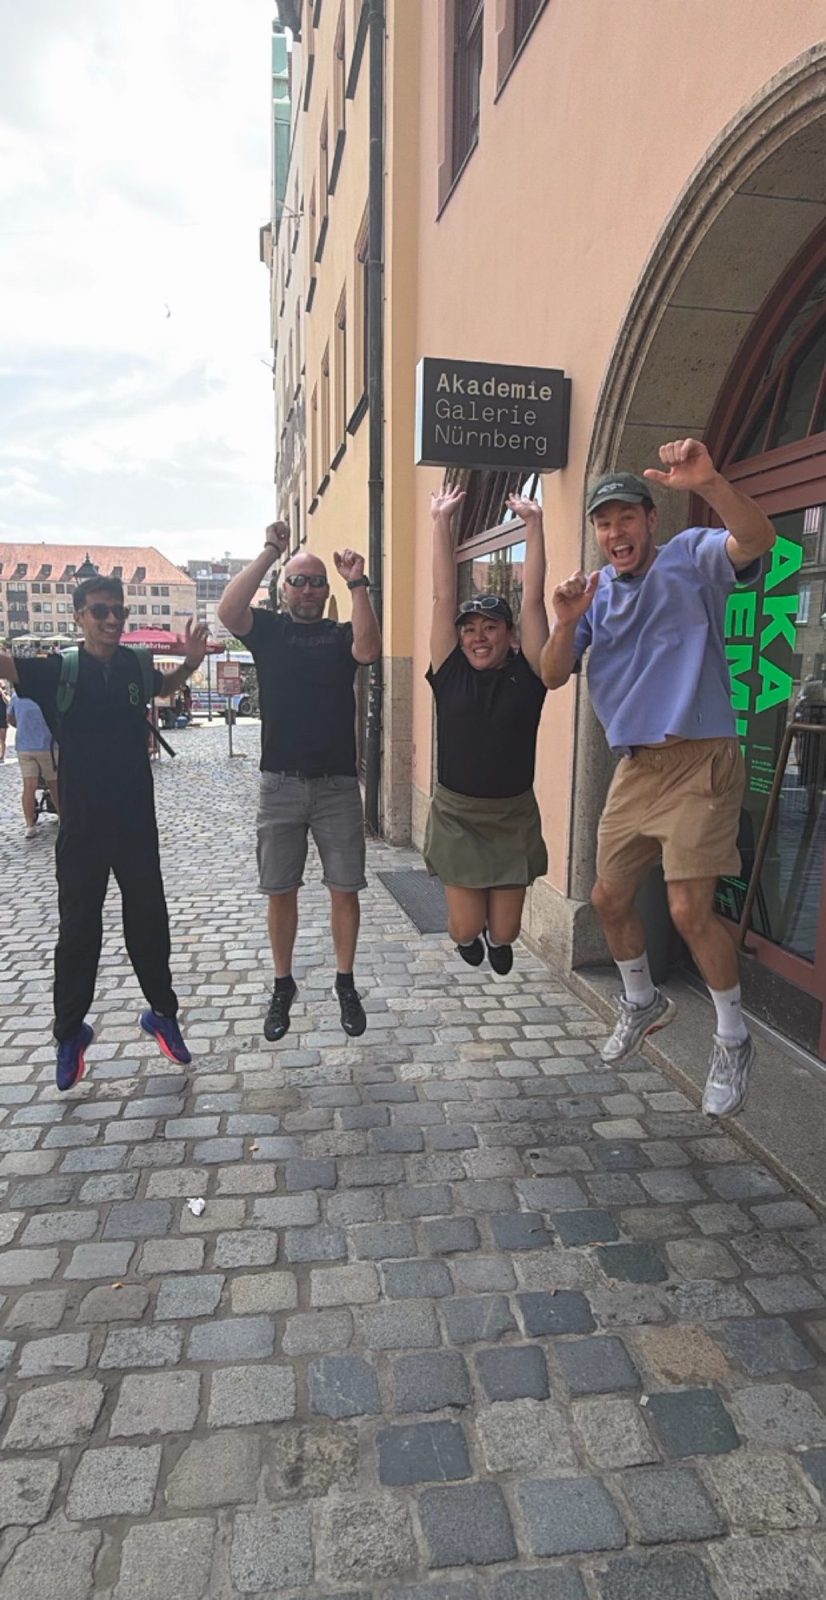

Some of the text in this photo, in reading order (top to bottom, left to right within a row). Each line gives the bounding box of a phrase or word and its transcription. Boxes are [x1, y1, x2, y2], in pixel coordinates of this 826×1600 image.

[436, 373, 552, 401] Akademie
[435, 398, 537, 426] Galerie
[434, 424, 547, 456] Nürnberg
[755, 535, 803, 714] AKA
